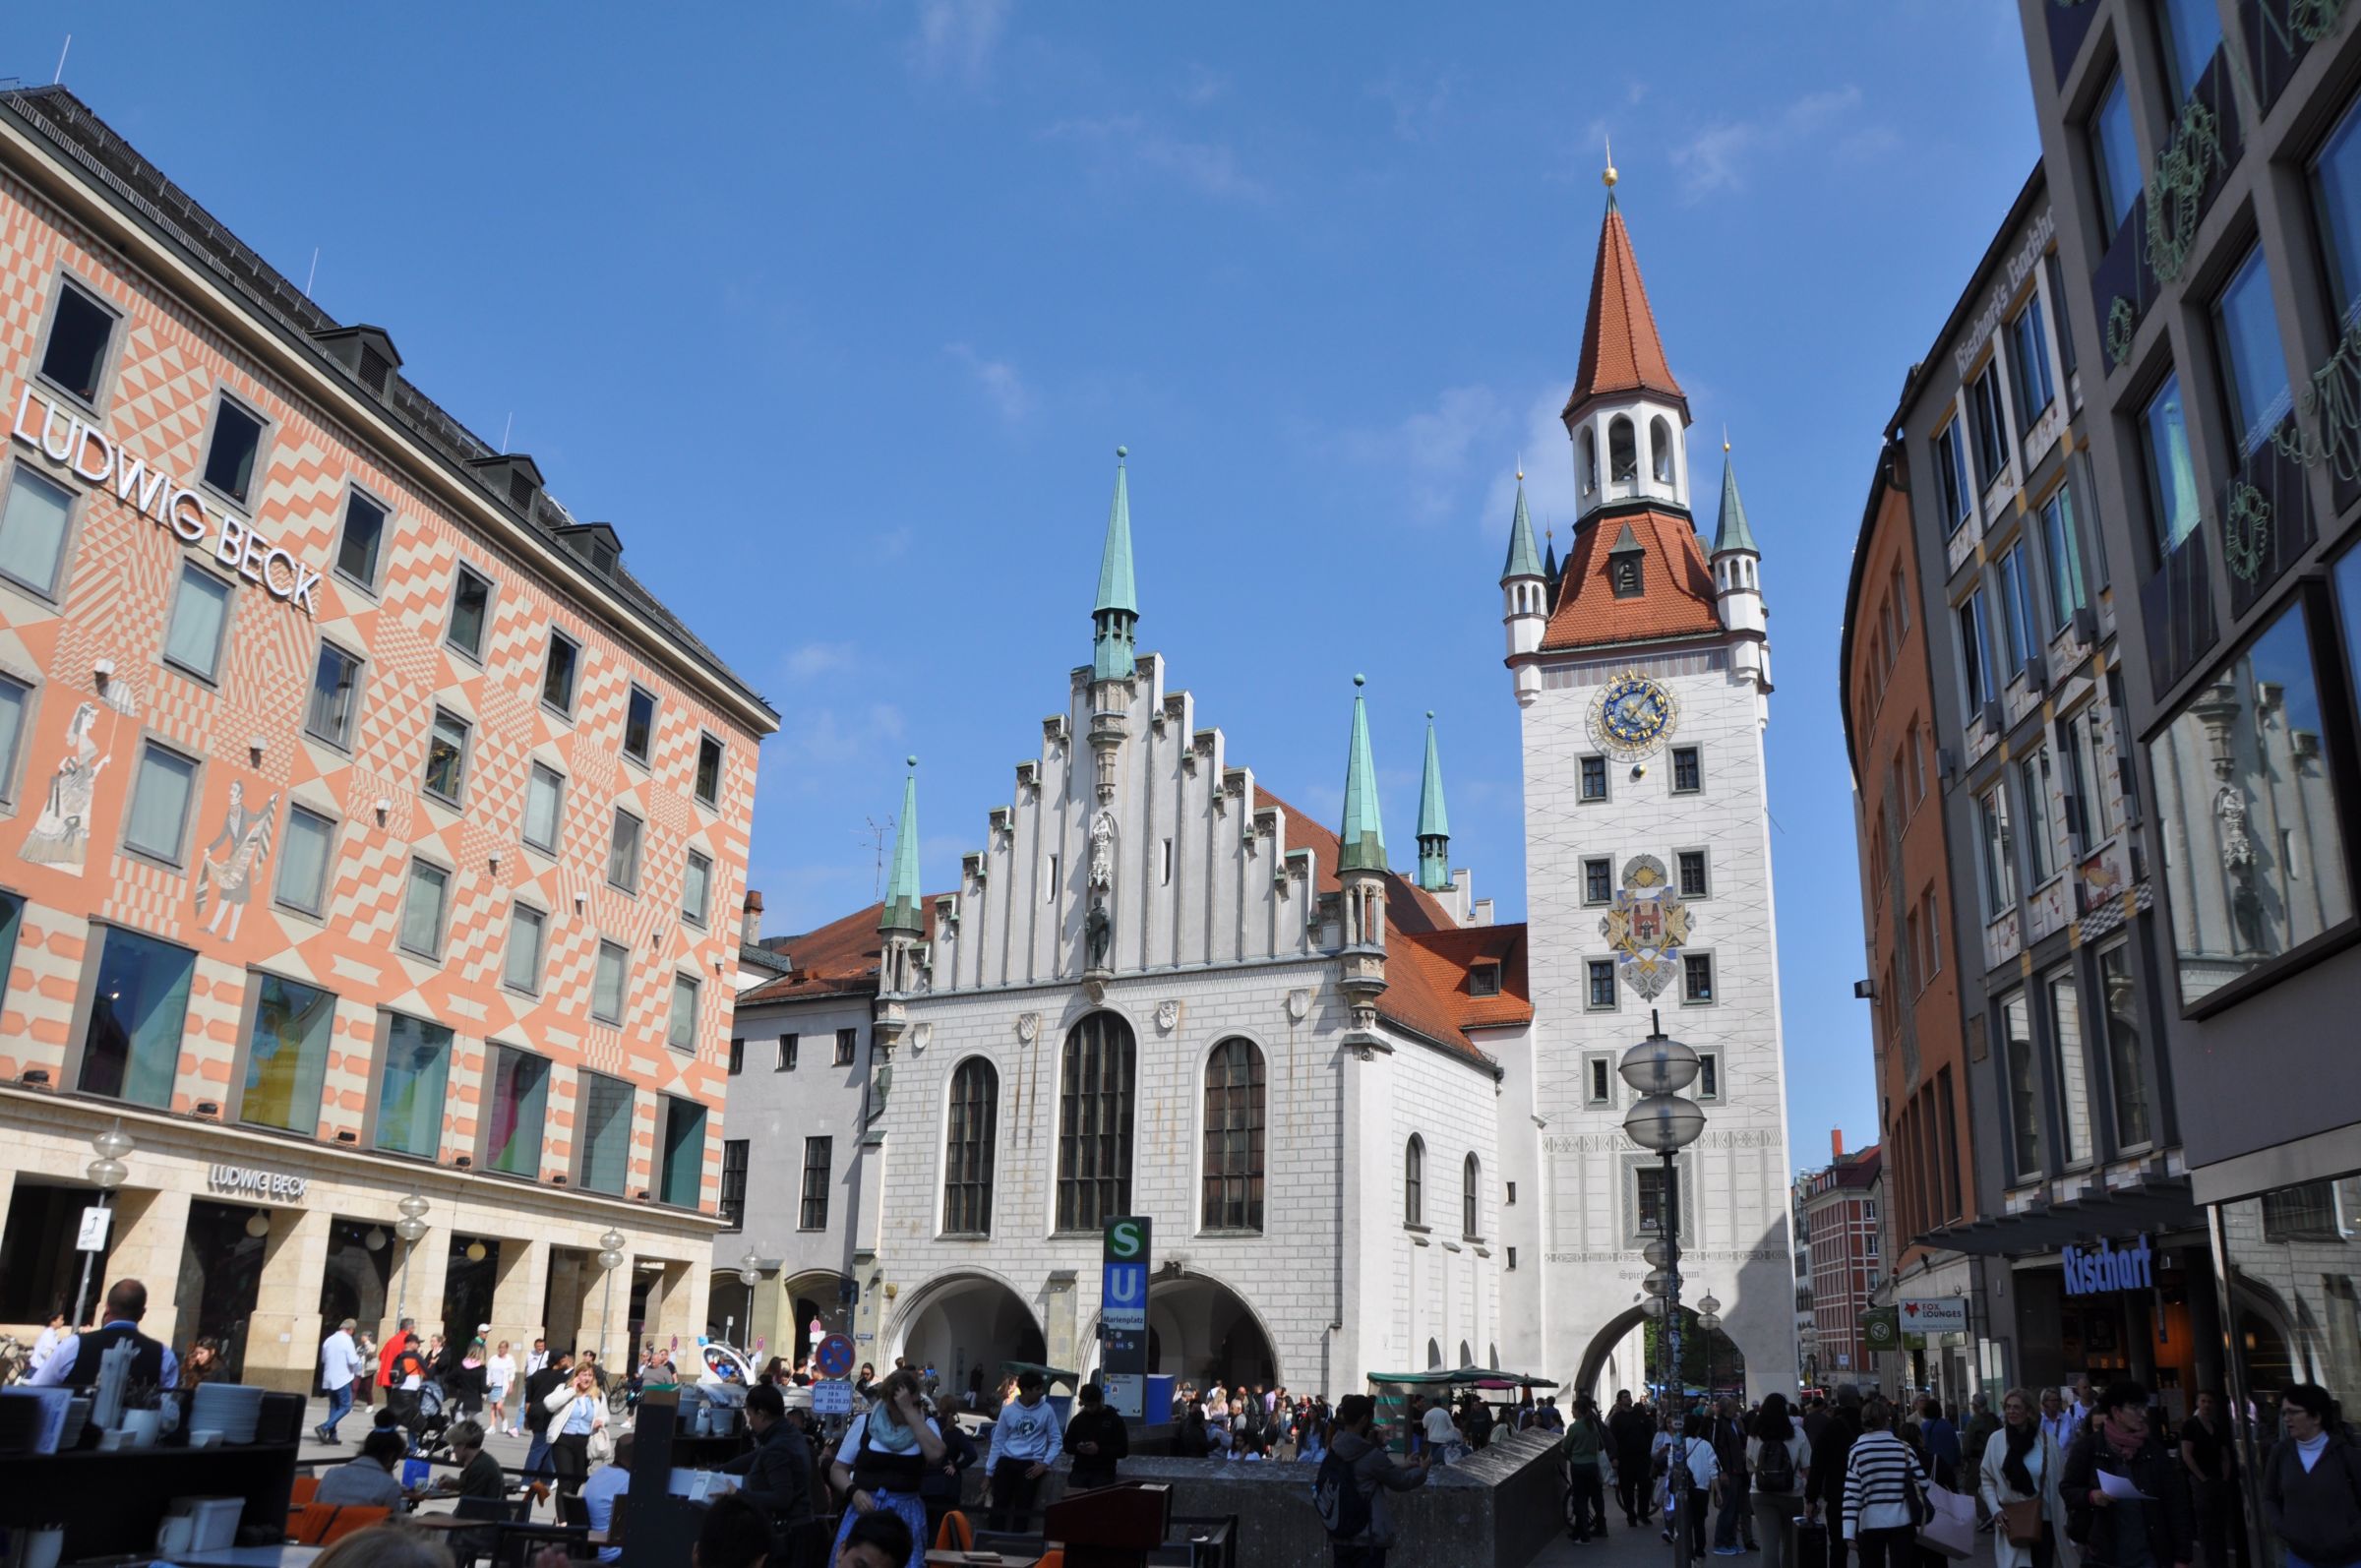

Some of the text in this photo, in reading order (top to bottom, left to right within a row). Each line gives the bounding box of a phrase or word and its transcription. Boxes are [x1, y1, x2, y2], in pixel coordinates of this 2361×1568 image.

[13, 385, 322, 616] LUDWIG BECK
[211, 1164, 309, 1196] LUDWIG BECK
[1113, 1223, 1139, 1257] S
[2062, 1232, 2151, 1296] Rischart
[1112, 1268, 1136, 1302] U
[1103, 1315, 1144, 1324] Marienplatz
